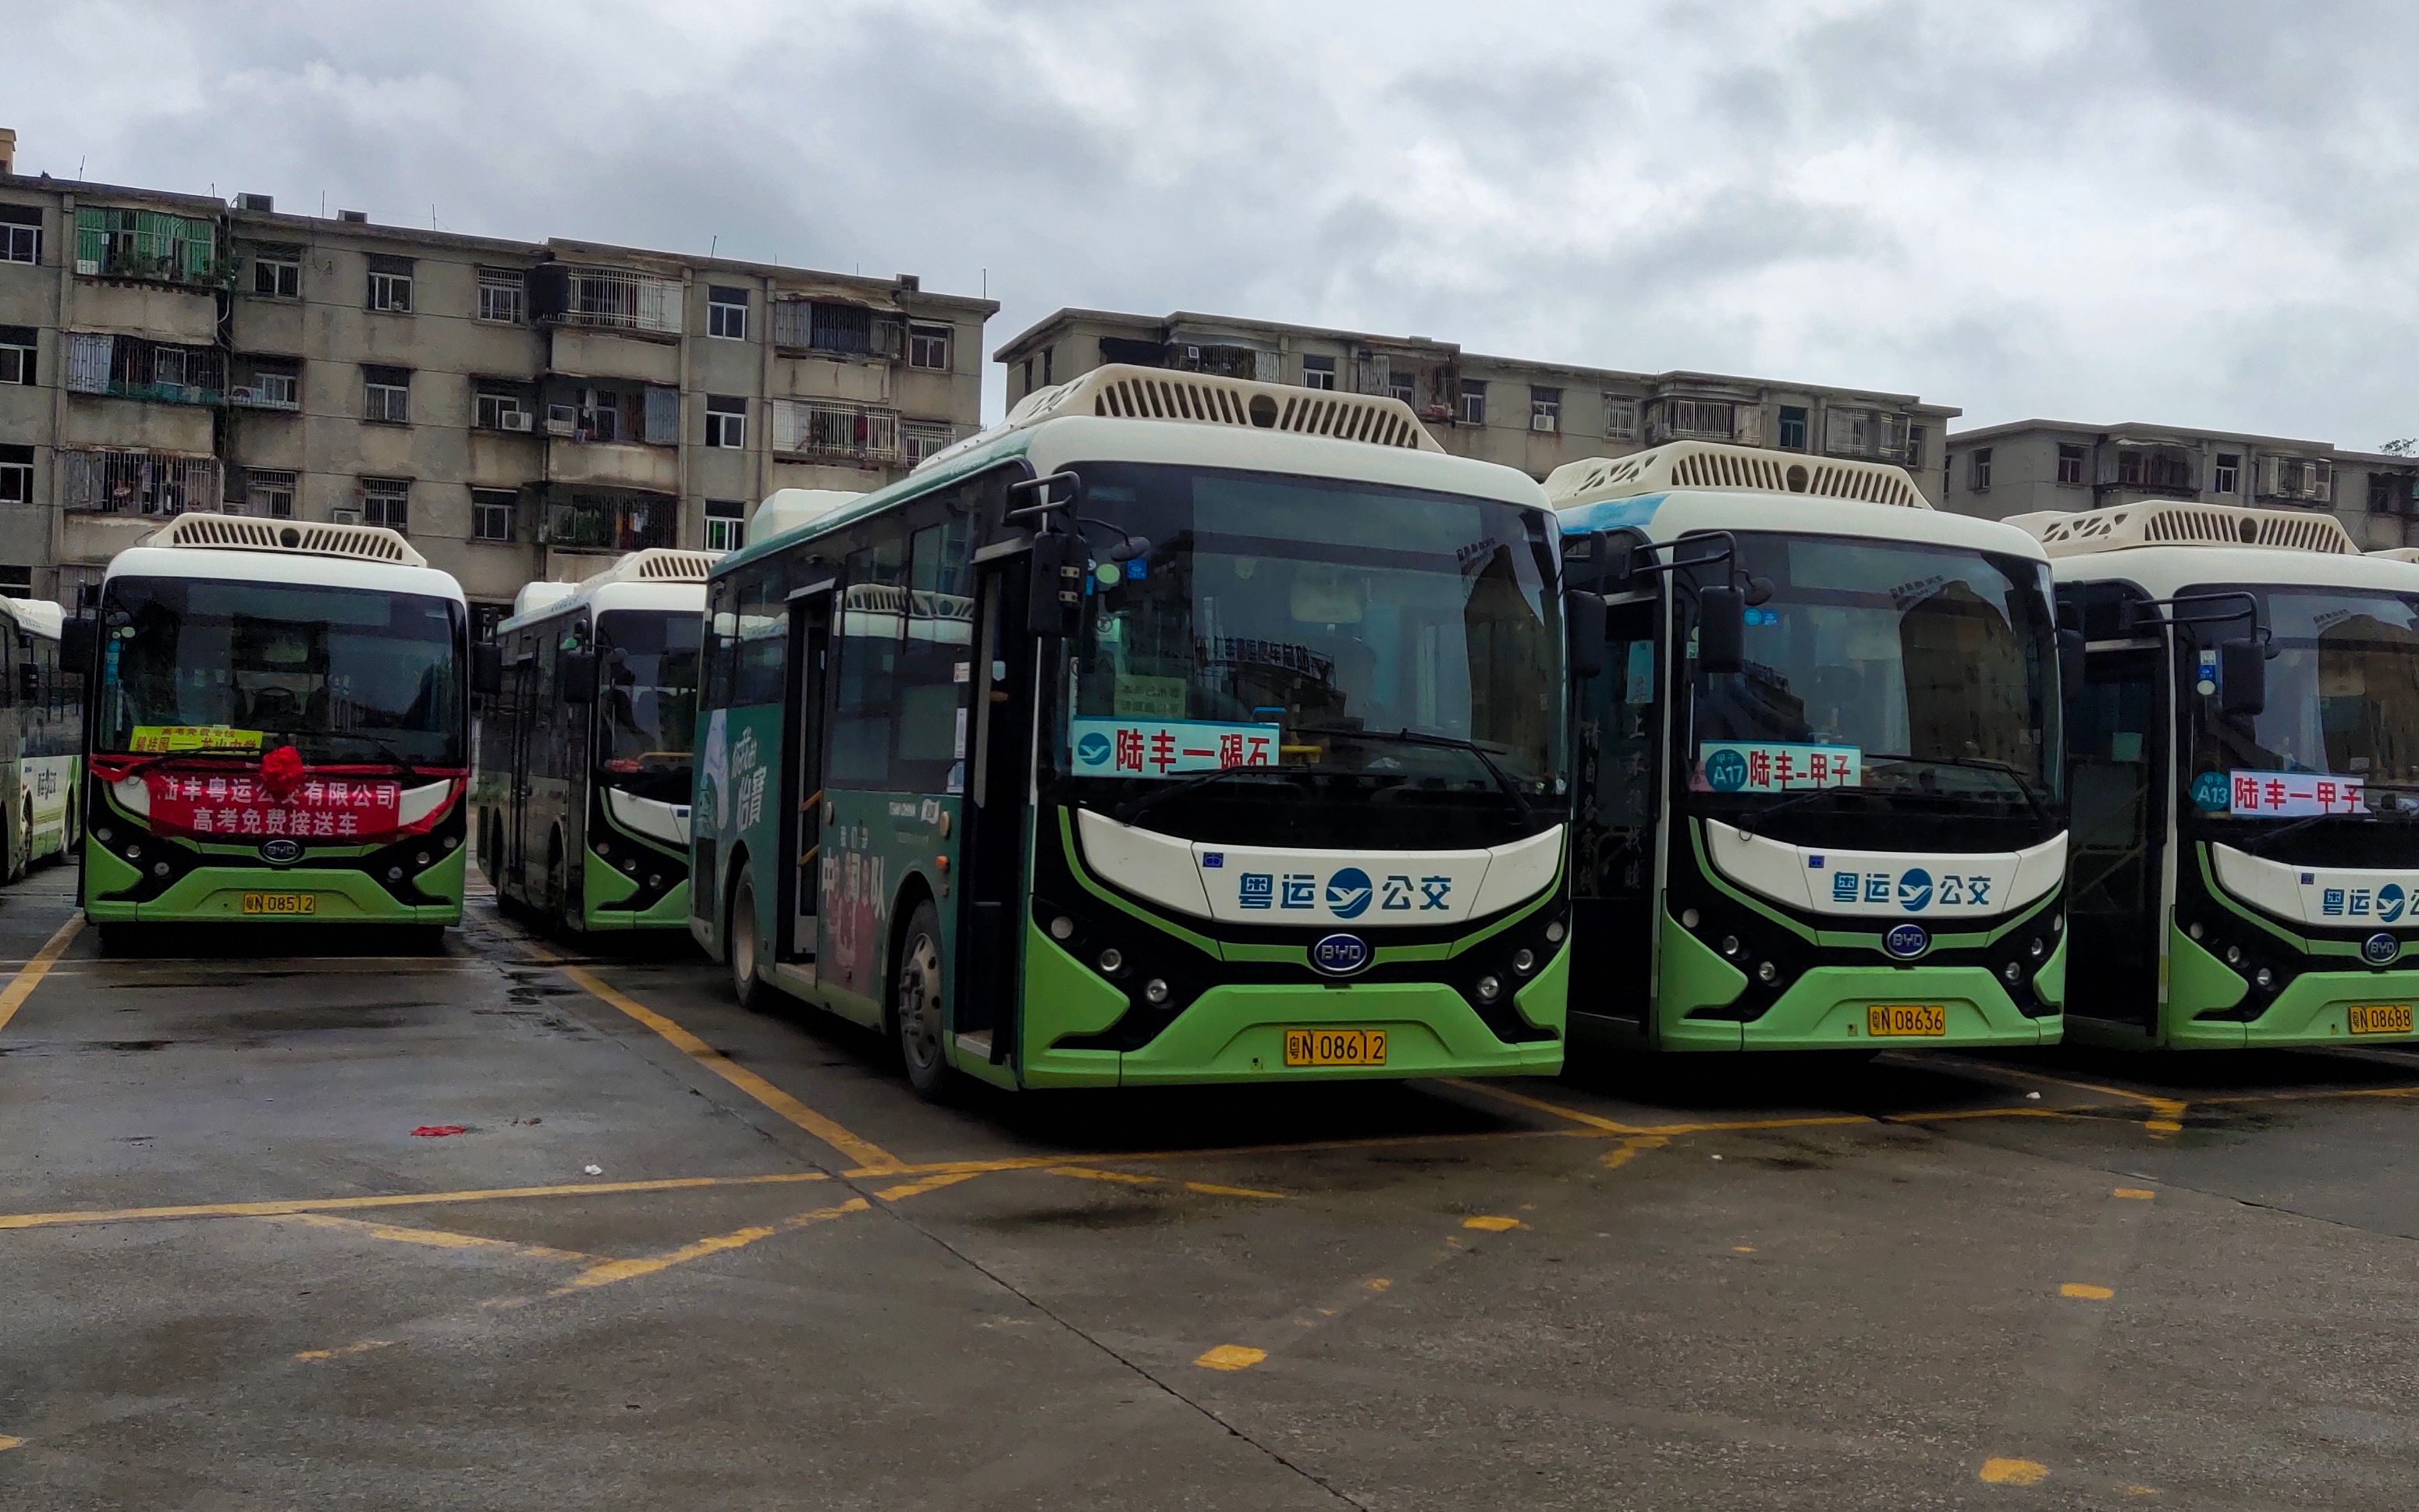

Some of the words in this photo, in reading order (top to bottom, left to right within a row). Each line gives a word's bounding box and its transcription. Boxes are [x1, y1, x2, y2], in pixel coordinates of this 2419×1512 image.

[1713, 765, 1743, 785] A17
[2197, 786, 2228, 804] A13
[194, 807, 358, 836] 高考免费接送车
[267, 846, 296, 855] BYD
[1238, 871, 1316, 910] 粤运
[1381, 875, 1452, 910] 公交
[1832, 871, 1892, 903] 粤运
[1938, 875, 1992, 905] 公交
[2321, 887, 2371, 916] 粤运
[1892, 933, 1923, 947] BYD
[2370, 942, 2396, 955] BYD
[1320, 944, 1362, 961] BYD
